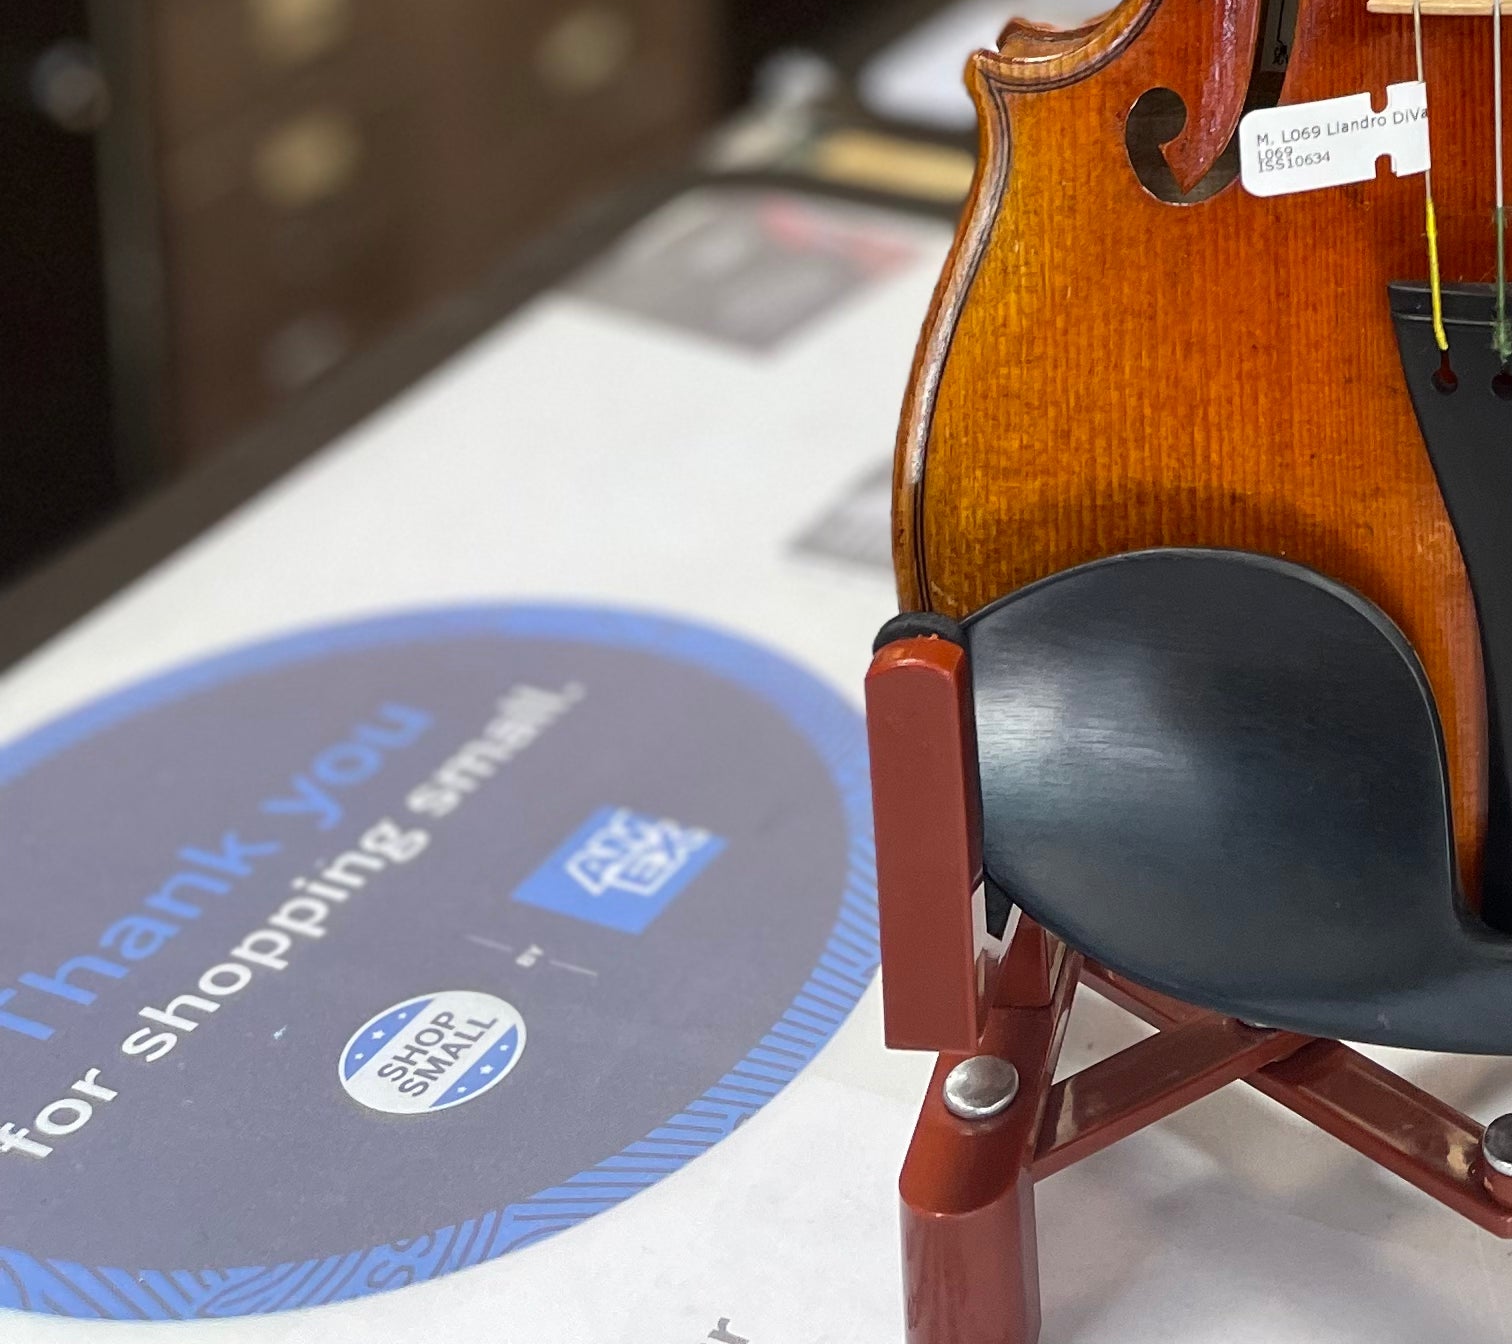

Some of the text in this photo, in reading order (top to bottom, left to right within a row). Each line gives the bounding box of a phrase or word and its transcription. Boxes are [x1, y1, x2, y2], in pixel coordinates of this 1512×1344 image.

[1258, 150, 1331, 173] ISS10634
[0, 701, 433, 1041] Thank you
[0, 1068, 118, 1158] for
[121, 816, 430, 1063] shopping
[377, 1011, 456, 1082] SHOP
[398, 1018, 499, 1097] SMALL
